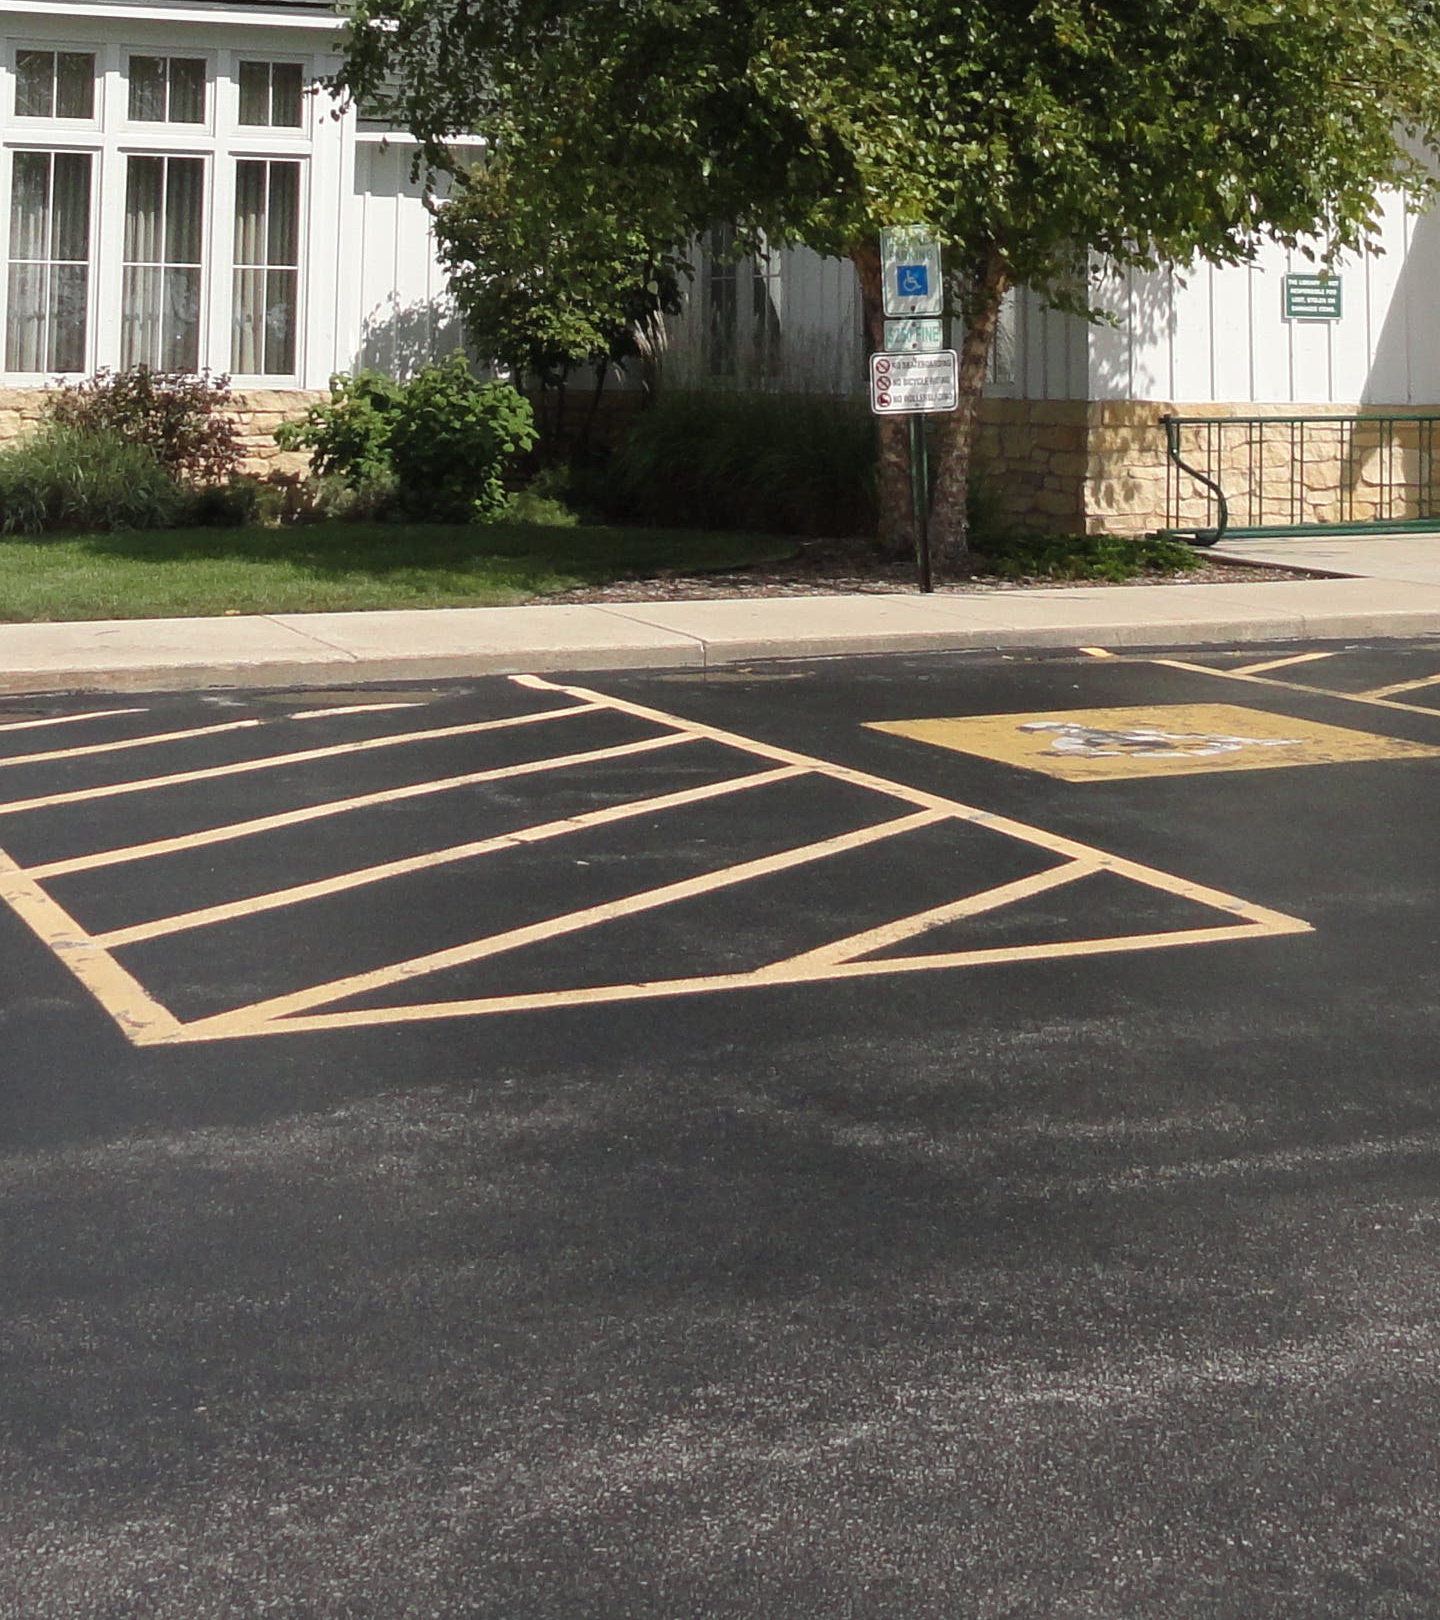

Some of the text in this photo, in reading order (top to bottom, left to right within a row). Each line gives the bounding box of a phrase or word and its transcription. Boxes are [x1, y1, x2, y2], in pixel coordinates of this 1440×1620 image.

[916, 326, 939, 342] FINE
[893, 378, 902, 386] NO
[893, 395, 902, 403] NO
